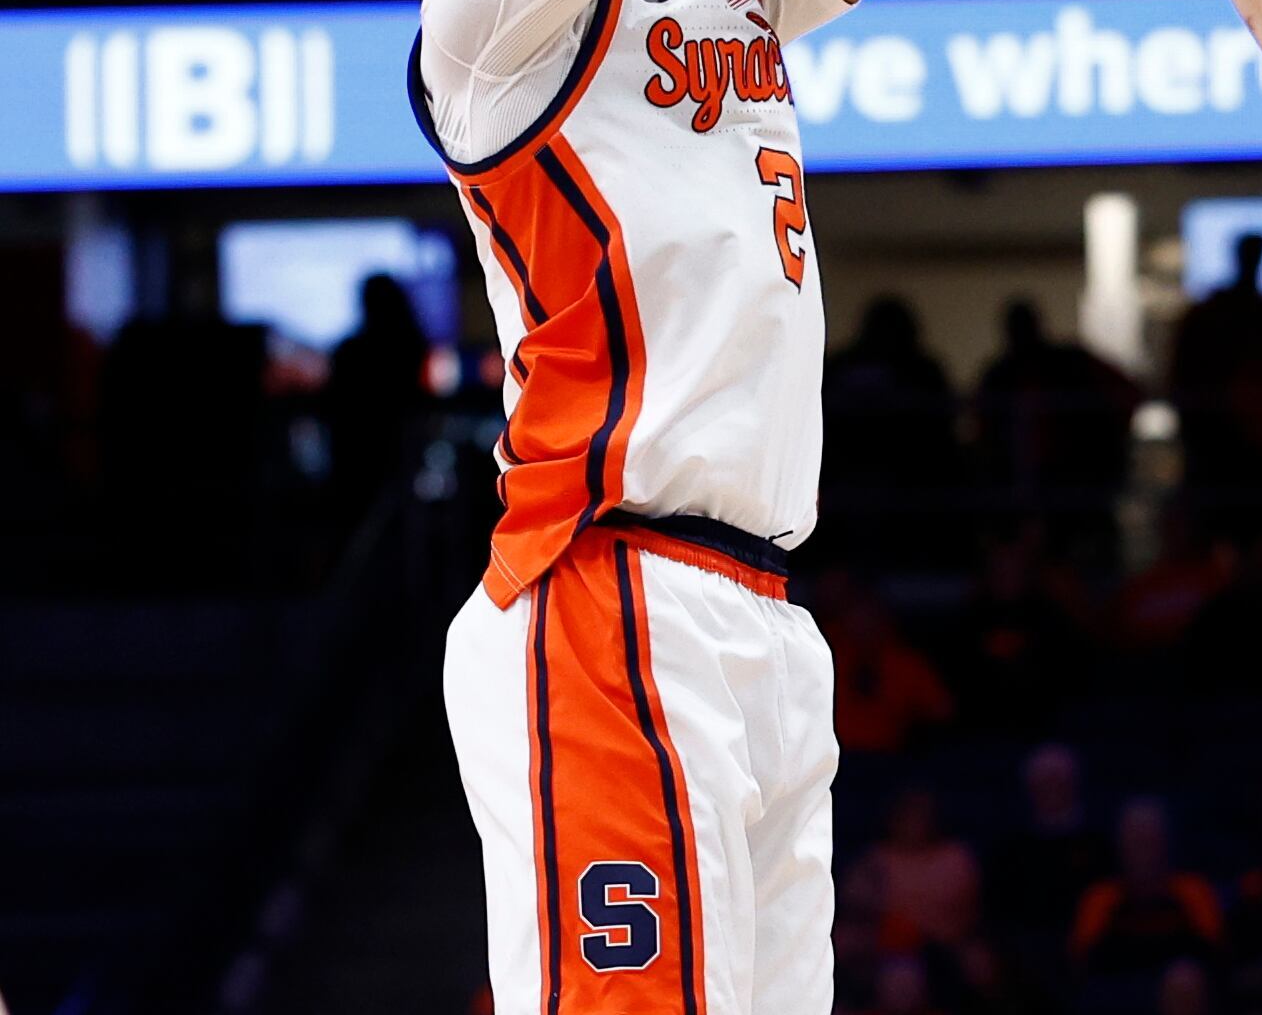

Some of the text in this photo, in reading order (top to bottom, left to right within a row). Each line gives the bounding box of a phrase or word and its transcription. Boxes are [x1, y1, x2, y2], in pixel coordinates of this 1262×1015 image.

[645, 16, 794, 133] Syrac
[755, 146, 806, 294] 2
[577, 860, 661, 973] S
